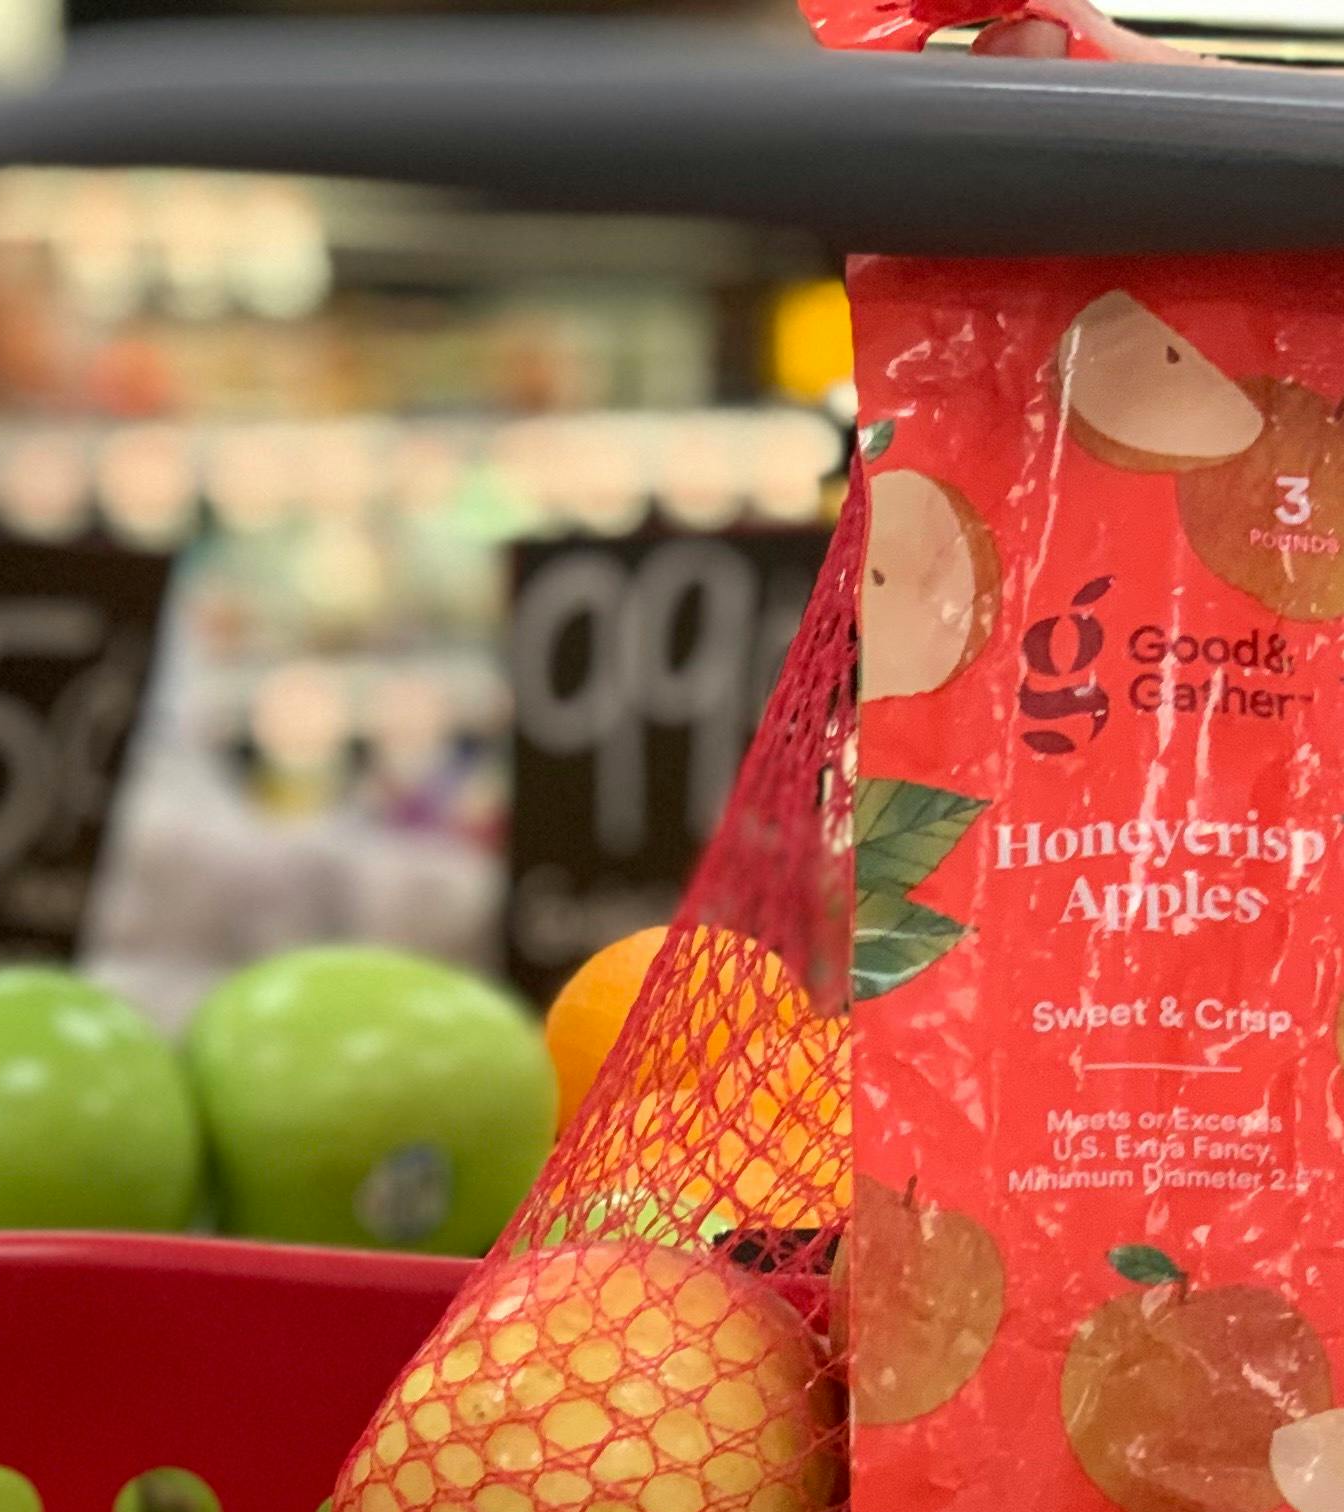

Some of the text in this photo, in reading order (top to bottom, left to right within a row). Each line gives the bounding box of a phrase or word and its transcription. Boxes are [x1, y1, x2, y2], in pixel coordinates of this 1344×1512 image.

[1274, 474, 1313, 526] 3
[1249, 527, 1341, 555] POUNDS
[993, 810, 1328, 890] Honeycrisp
[1058, 868, 1262, 934] Apples
[1031, 996, 1293, 1040] Sweet & Crisp
[1046, 1106, 1283, 1135] Meets or Exceeds
[1115, 1136, 1186, 1161] Extra
[1008, 1168, 1134, 1193] Minimum
[1142, 1164, 1262, 1192] Diameter
